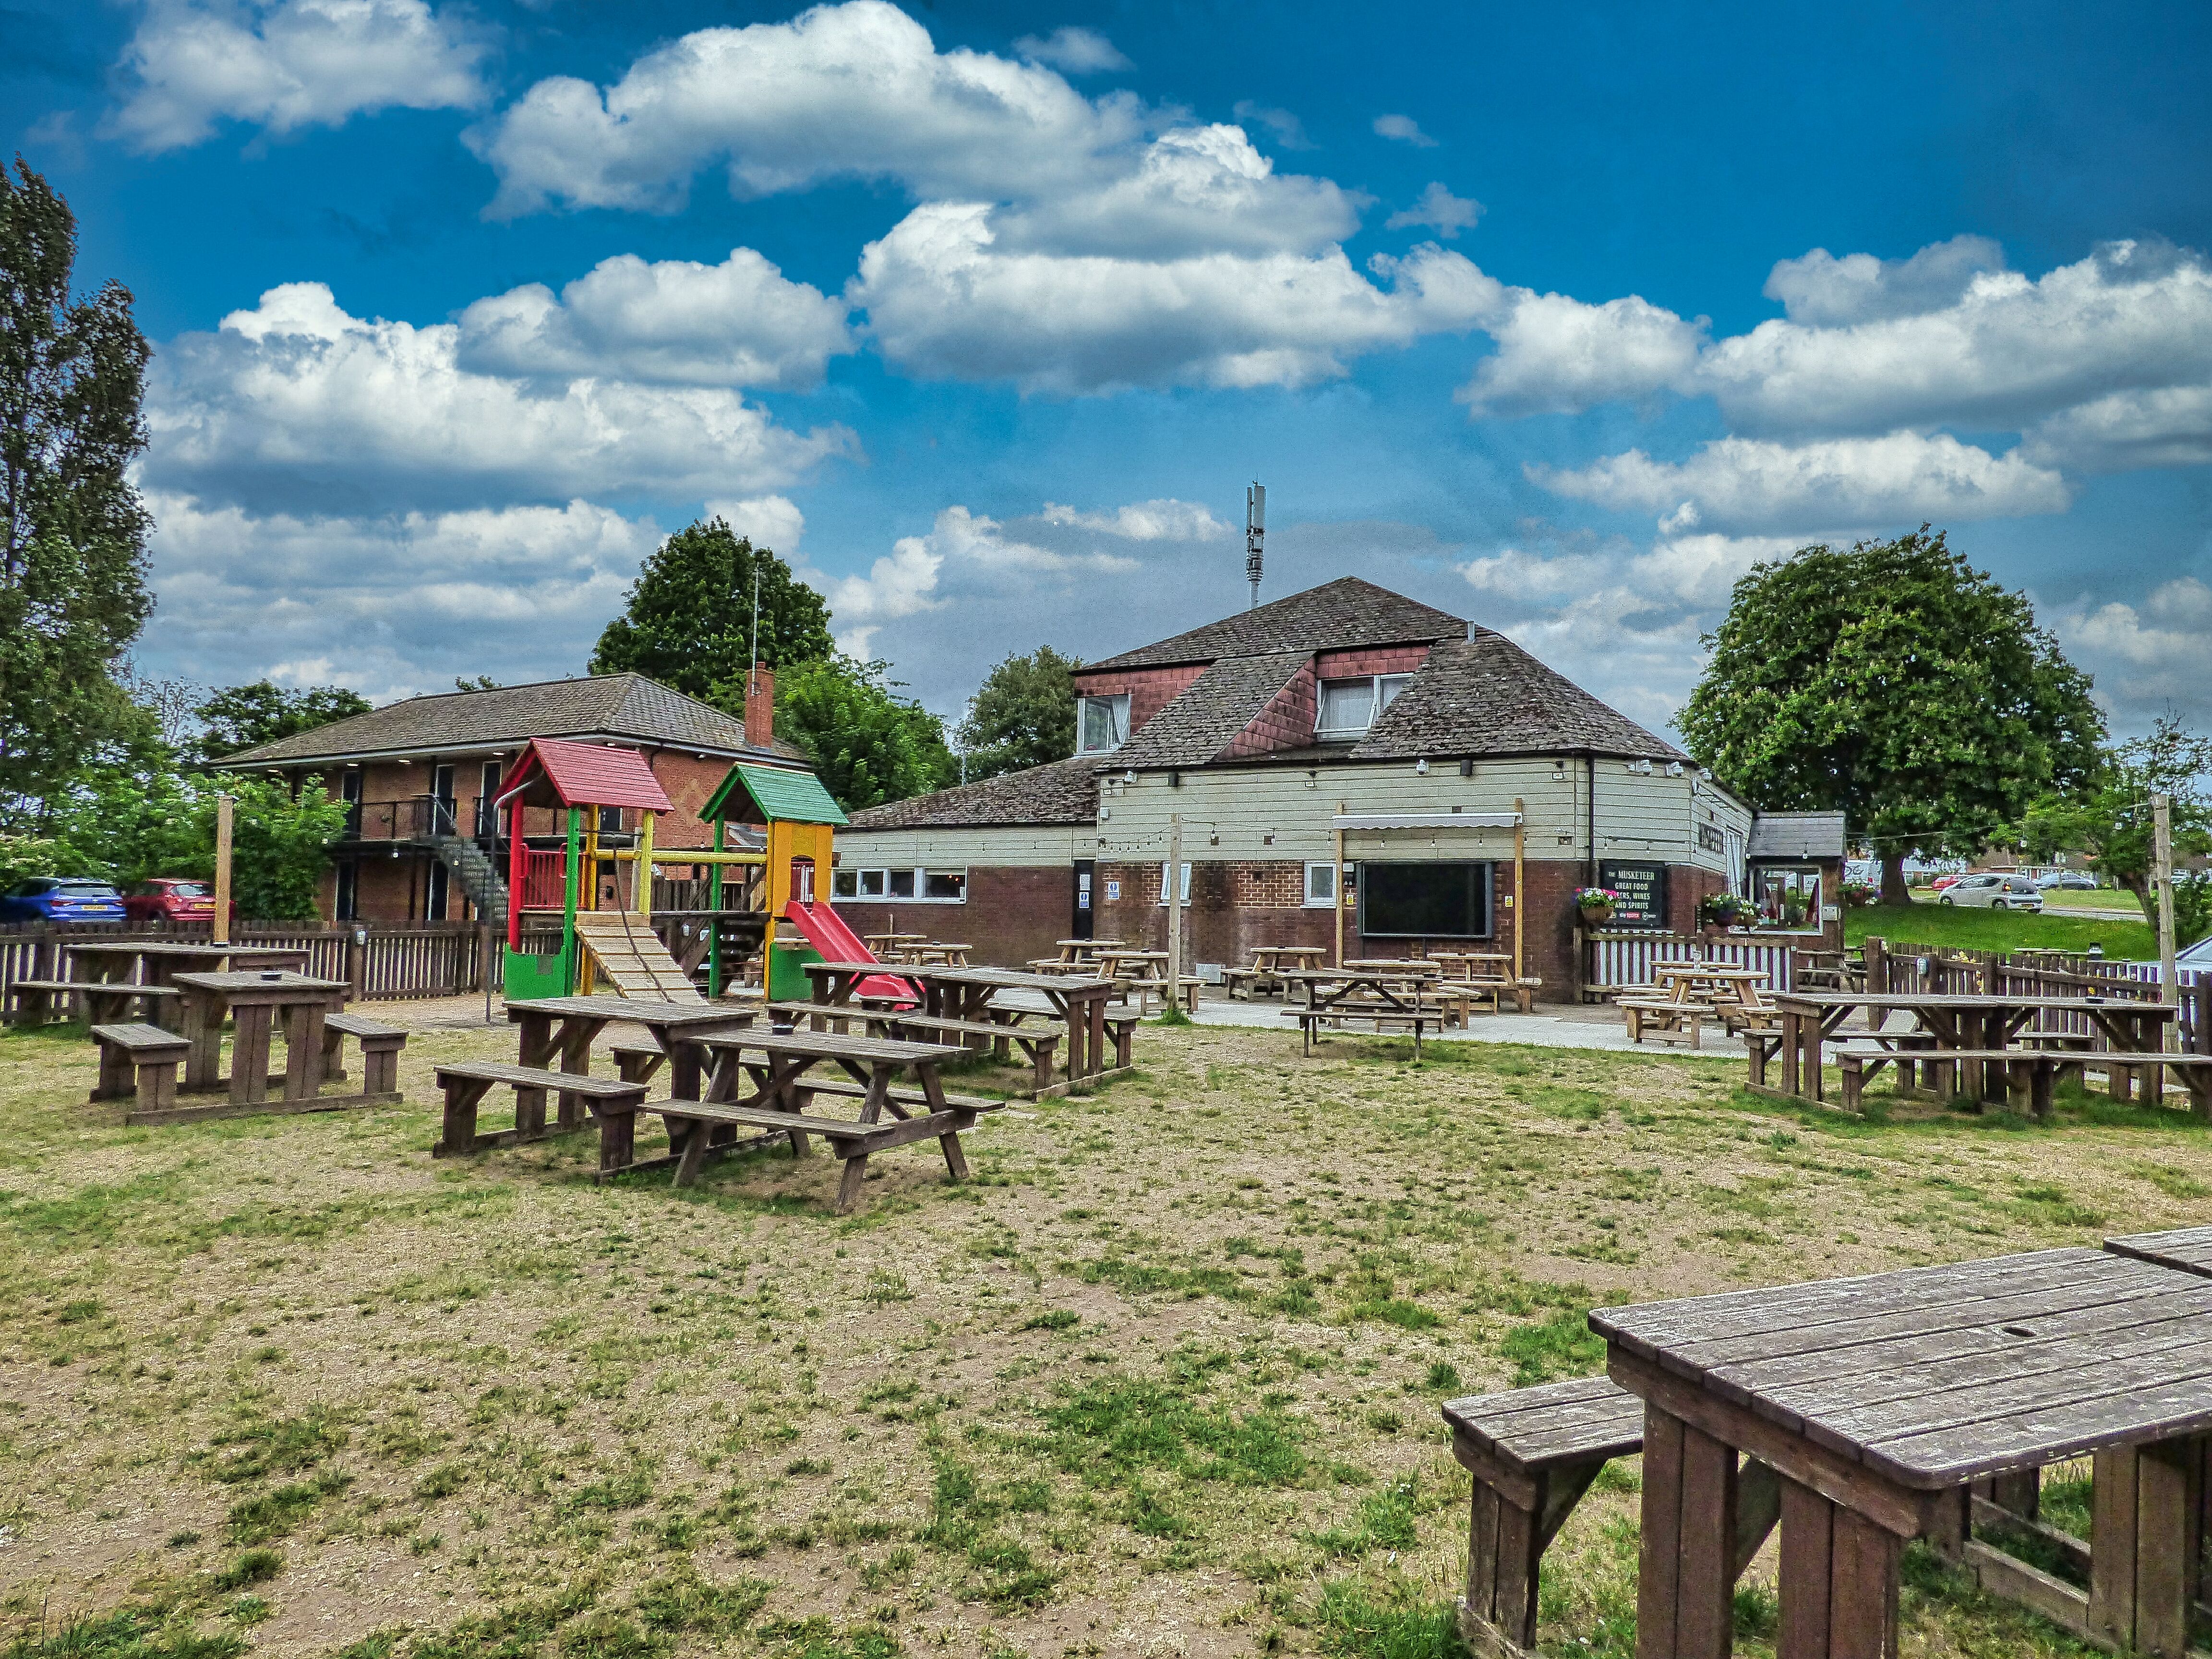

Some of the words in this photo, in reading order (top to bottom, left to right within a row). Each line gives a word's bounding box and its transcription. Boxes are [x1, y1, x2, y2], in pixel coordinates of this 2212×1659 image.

[1618, 870, 1655, 880] MUSKETEER
[1614, 882, 1632, 890] GREAT
[1616, 892, 1632, 900] ERS,
